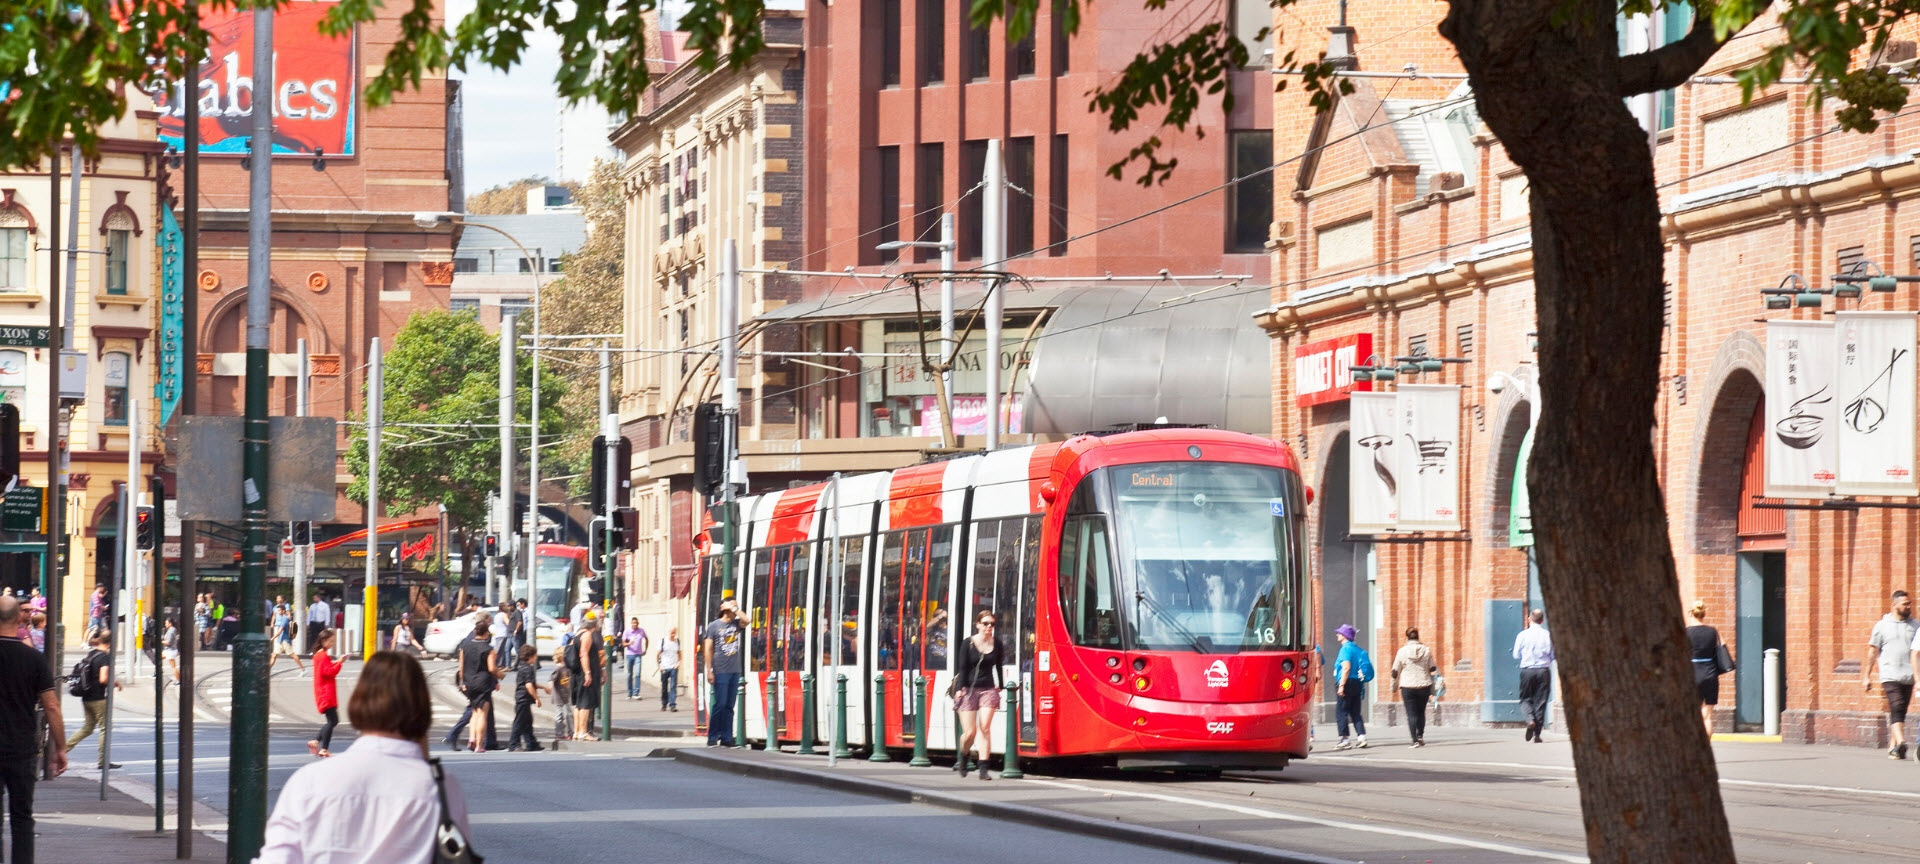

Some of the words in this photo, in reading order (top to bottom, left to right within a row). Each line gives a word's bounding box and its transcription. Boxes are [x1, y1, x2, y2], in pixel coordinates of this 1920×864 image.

[166, 231, 177, 315] CAPITOL
[0, 328, 30, 338] XON
[164, 328, 177, 400] SQUARE
[1296, 349, 1333, 396] MARKET
[1334, 344, 1357, 389] CITY
[1132, 473, 1173, 486] Central
[1254, 627, 1276, 644] 16
[1207, 722, 1234, 733] CAF
